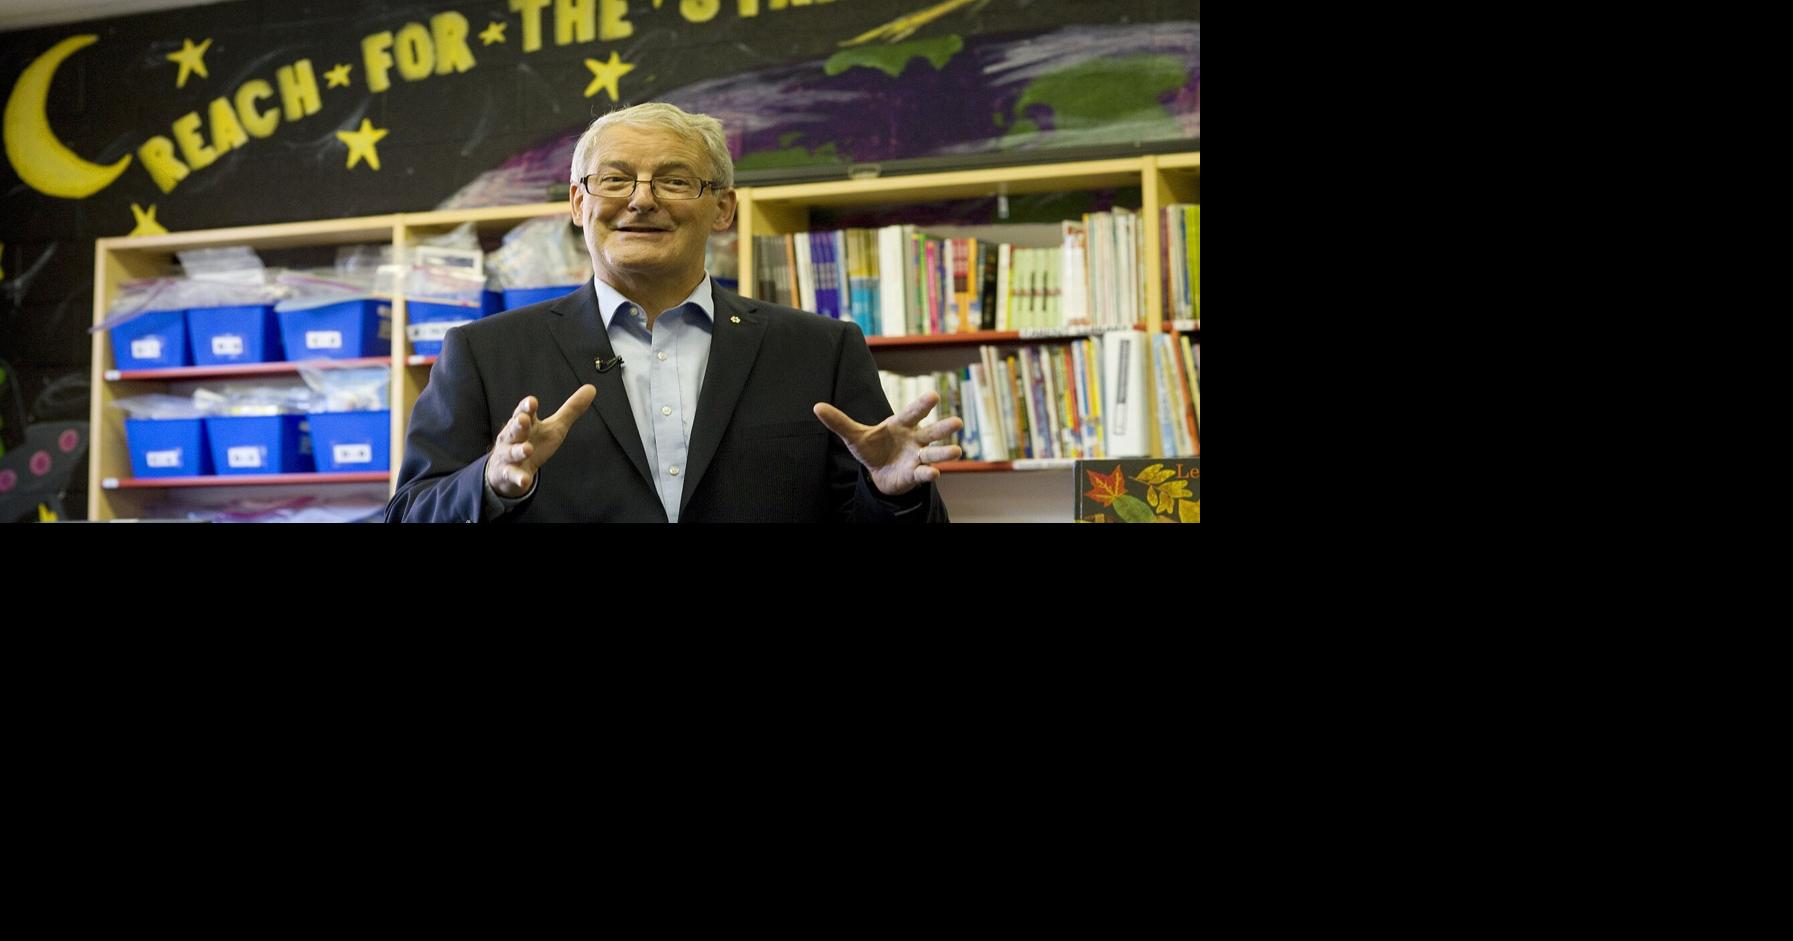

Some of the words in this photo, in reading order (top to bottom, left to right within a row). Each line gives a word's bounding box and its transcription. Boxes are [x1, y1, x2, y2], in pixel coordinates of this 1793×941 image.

[138, 58, 322, 194] REACH
[361, 11, 476, 94] FOR
[509, 0, 635, 53] THE
